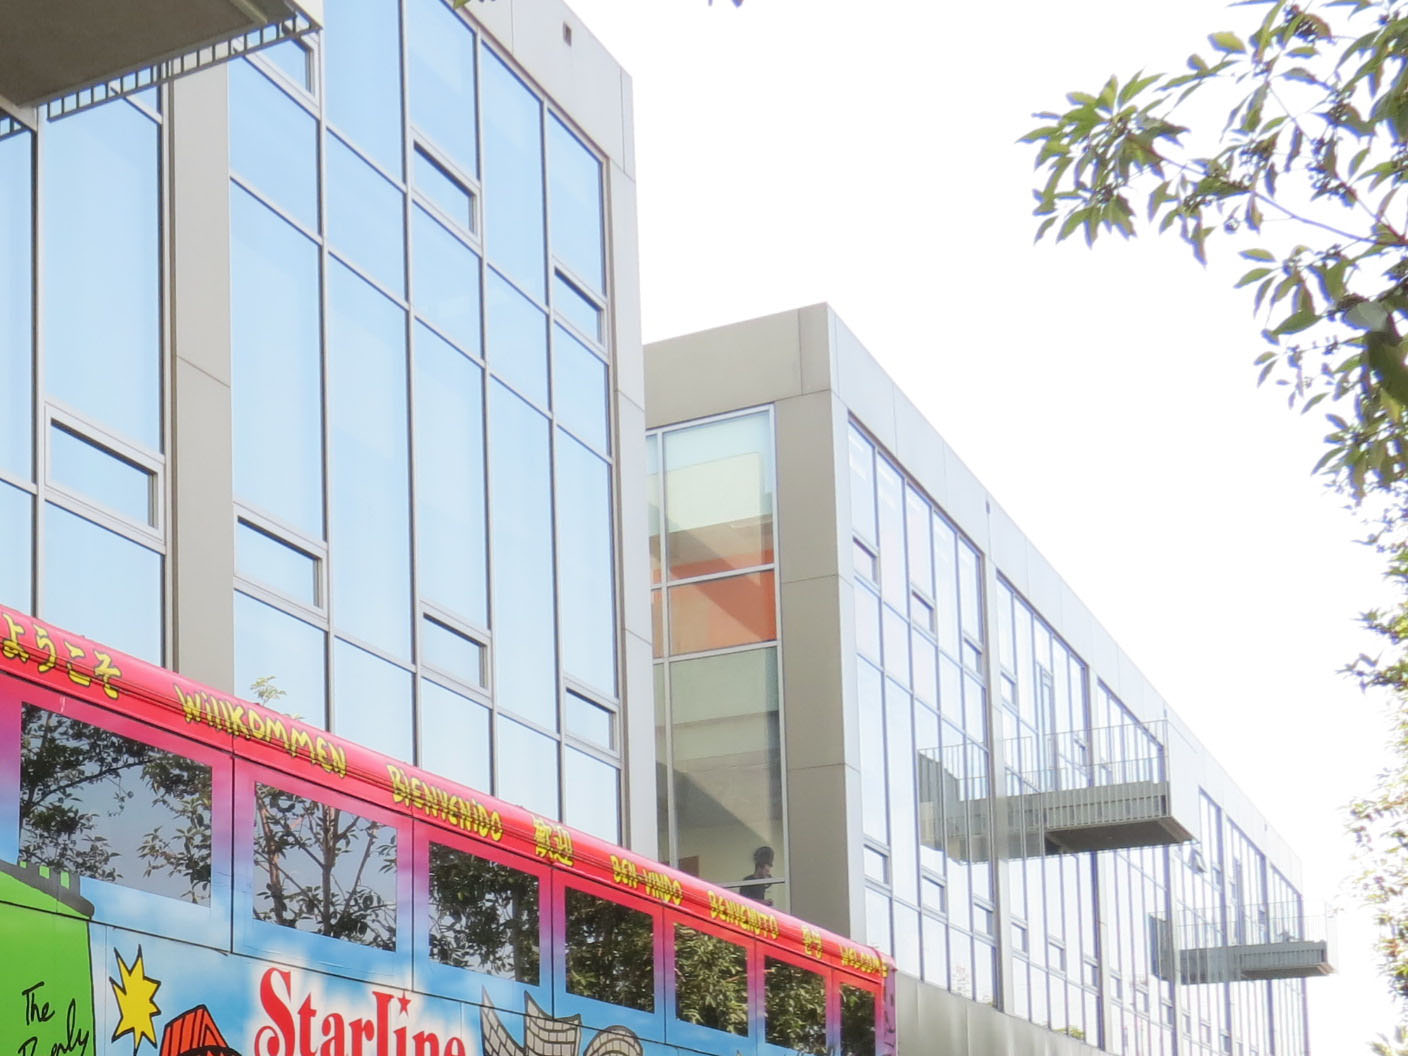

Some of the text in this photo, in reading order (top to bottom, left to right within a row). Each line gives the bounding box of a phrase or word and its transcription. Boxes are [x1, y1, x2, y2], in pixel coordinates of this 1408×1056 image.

[2, 612, 122, 700] ようこそ
[707, 890, 779, 939] BENVENUTO
[22, 981, 55, 1026] The
